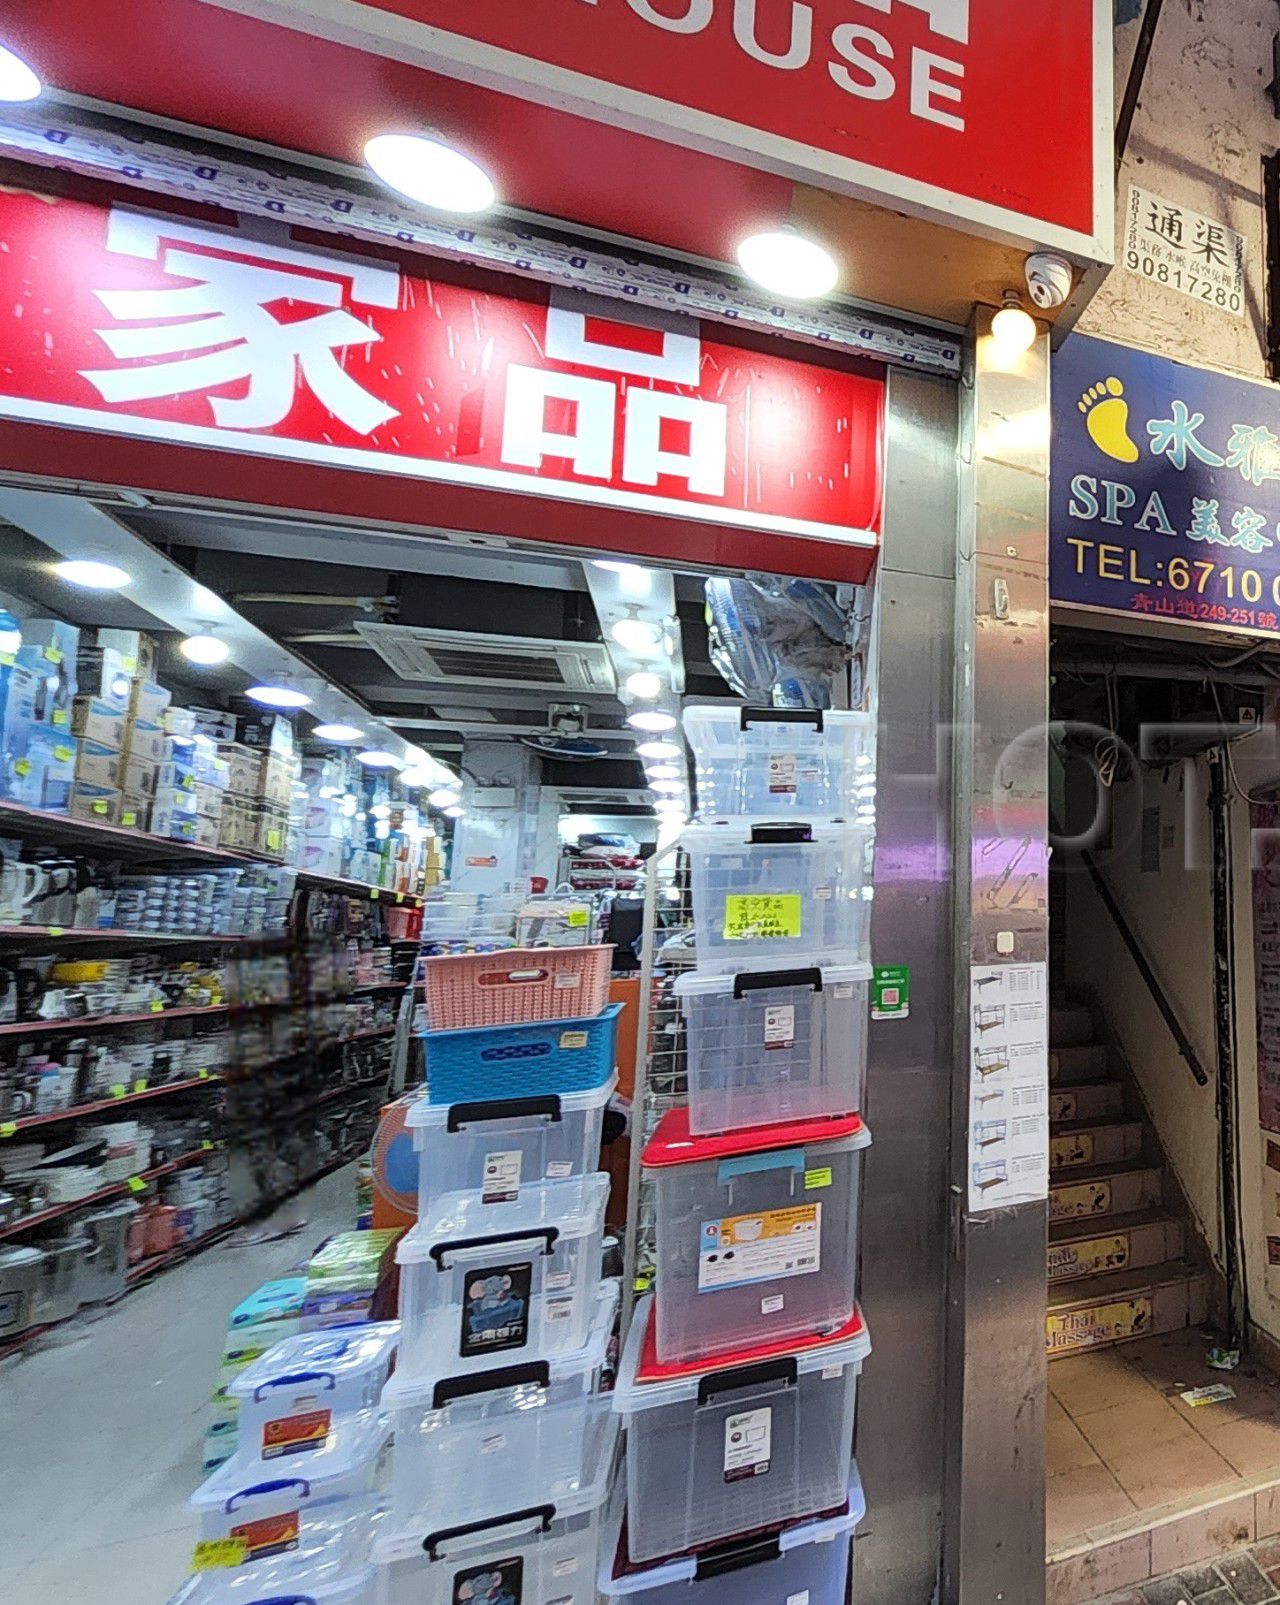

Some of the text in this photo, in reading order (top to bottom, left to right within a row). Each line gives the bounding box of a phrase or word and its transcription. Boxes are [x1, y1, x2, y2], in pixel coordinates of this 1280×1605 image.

[576, 0, 966, 132] USE
[1144, 200, 1231, 268] 通渠
[1127, 250, 1241, 312] 90817280
[77, 200, 728, 498] 家品
[1068, 474, 1178, 537] SPA
